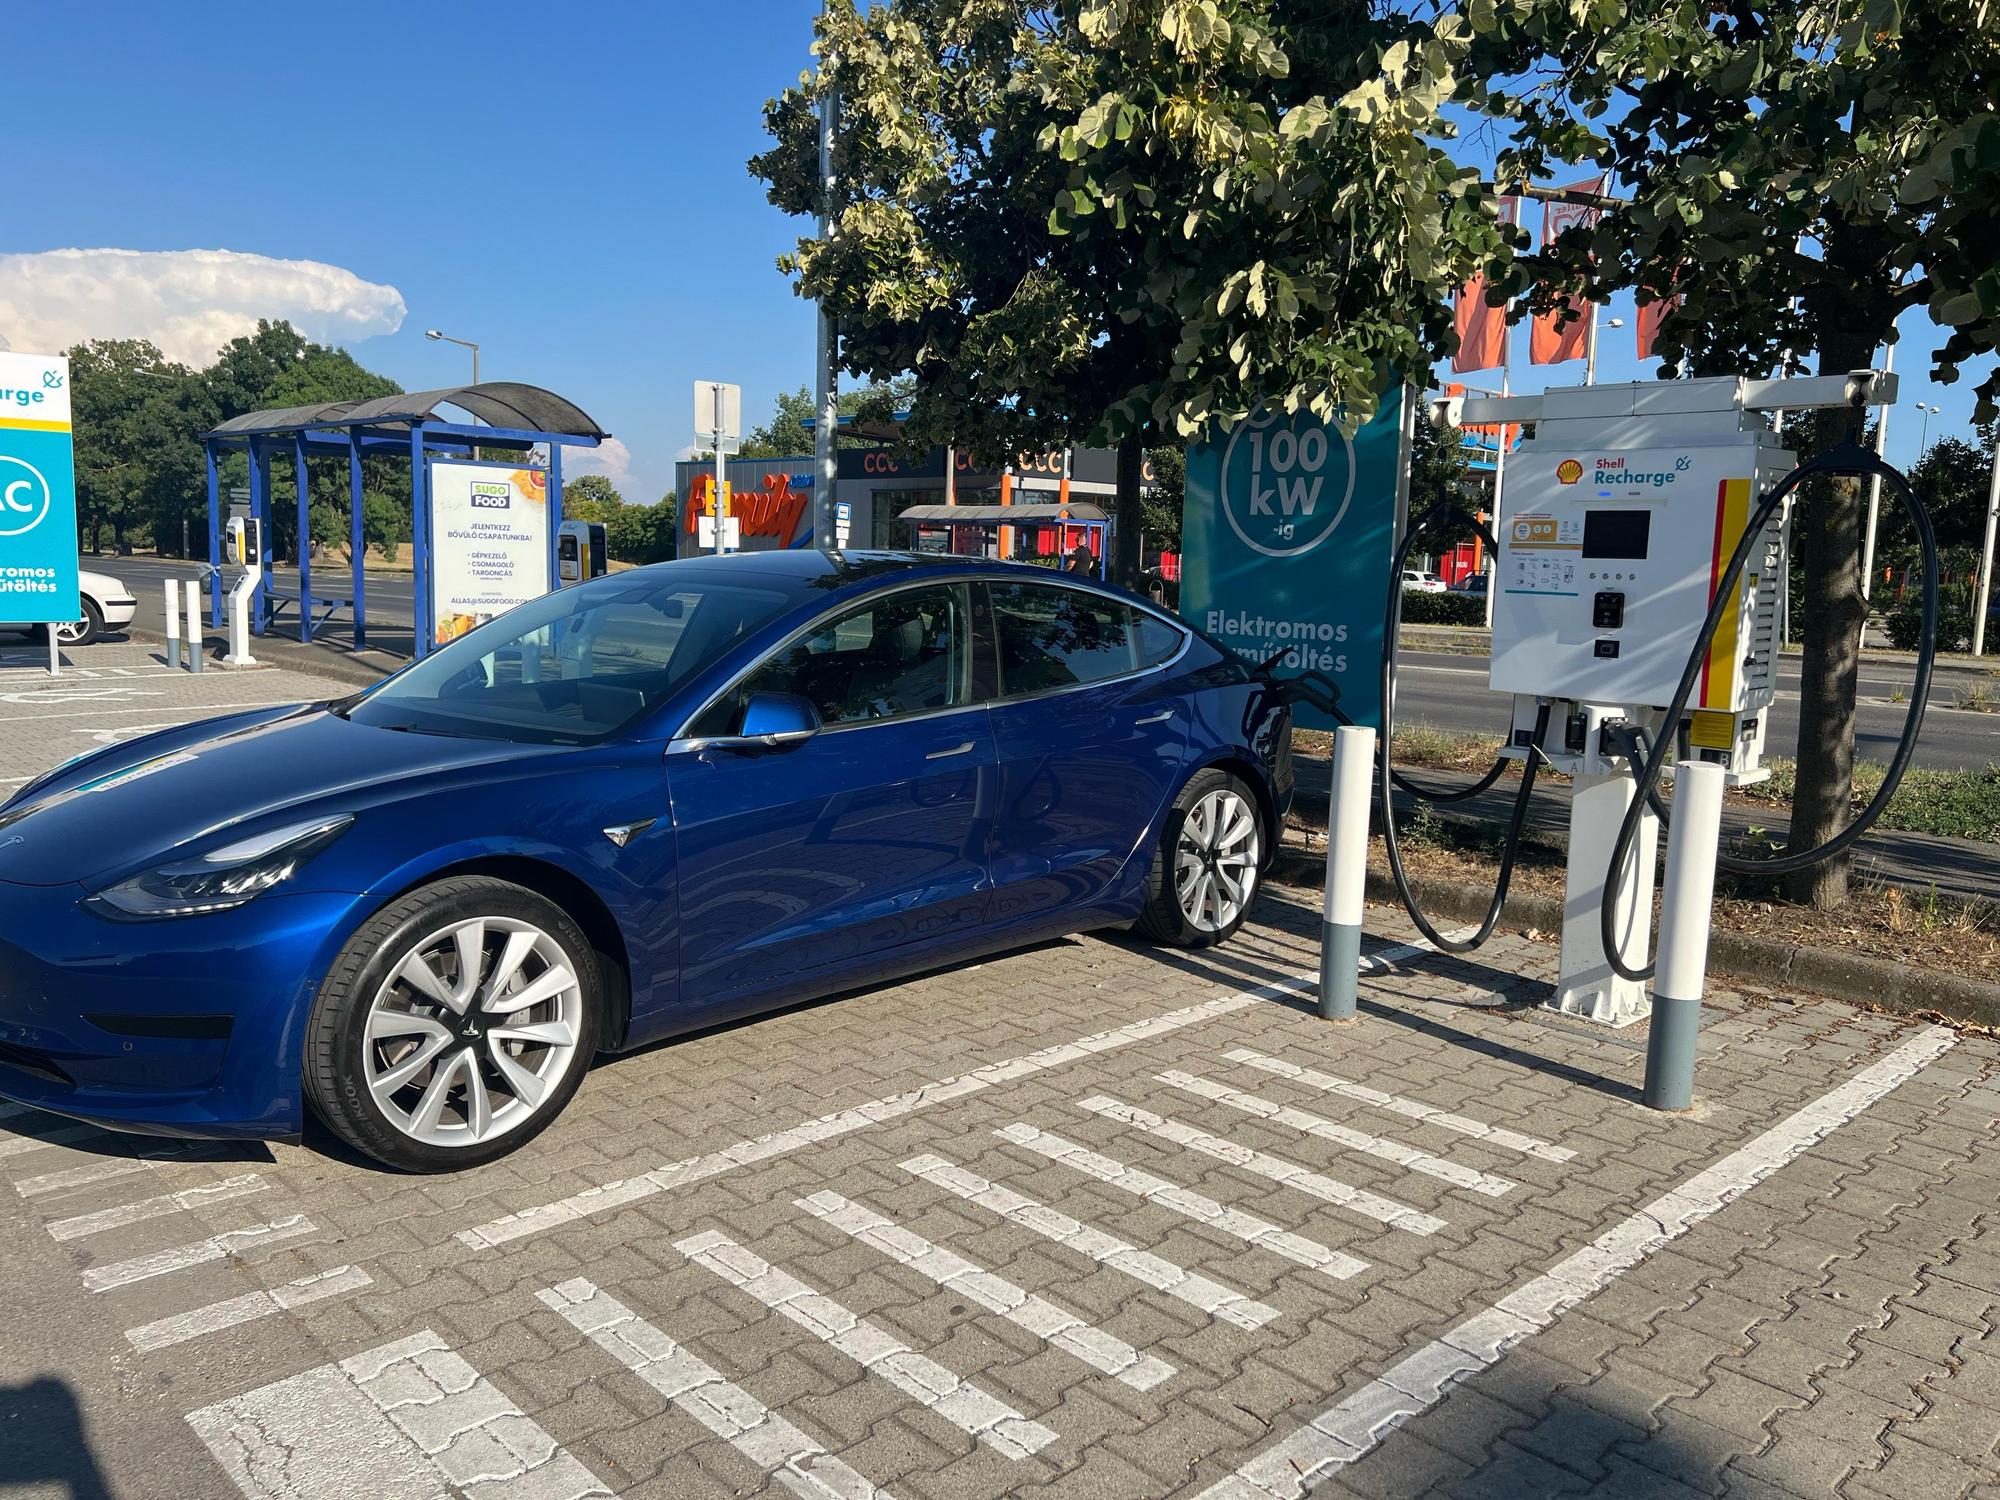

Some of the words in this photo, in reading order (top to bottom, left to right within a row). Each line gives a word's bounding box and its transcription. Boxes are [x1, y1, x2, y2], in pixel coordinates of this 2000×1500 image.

[0, 389, 44, 406] rge
[1249, 427, 1328, 472] 100
[1019, 449, 1062, 473] CCC
[1596, 458, 1625, 469] Shell
[1595, 469, 1676, 487] Recharge
[0, 480, 33, 513] C
[475, 484, 506, 495] SUGO
[1250, 472, 1325, 516] kW
[475, 496, 507, 507] FOOD
[685, 473, 808, 550] Fmily
[470, 523, 511, 531] JELENTKEZZ
[478, 533, 532, 541] CSAPATUNKBA!
[471, 569, 513, 577] TARGONCÁS
[1206, 610, 1348, 642] Elektromos
[1570, 762, 1578, 773] A
[1720, 753, 1729, 767] B
